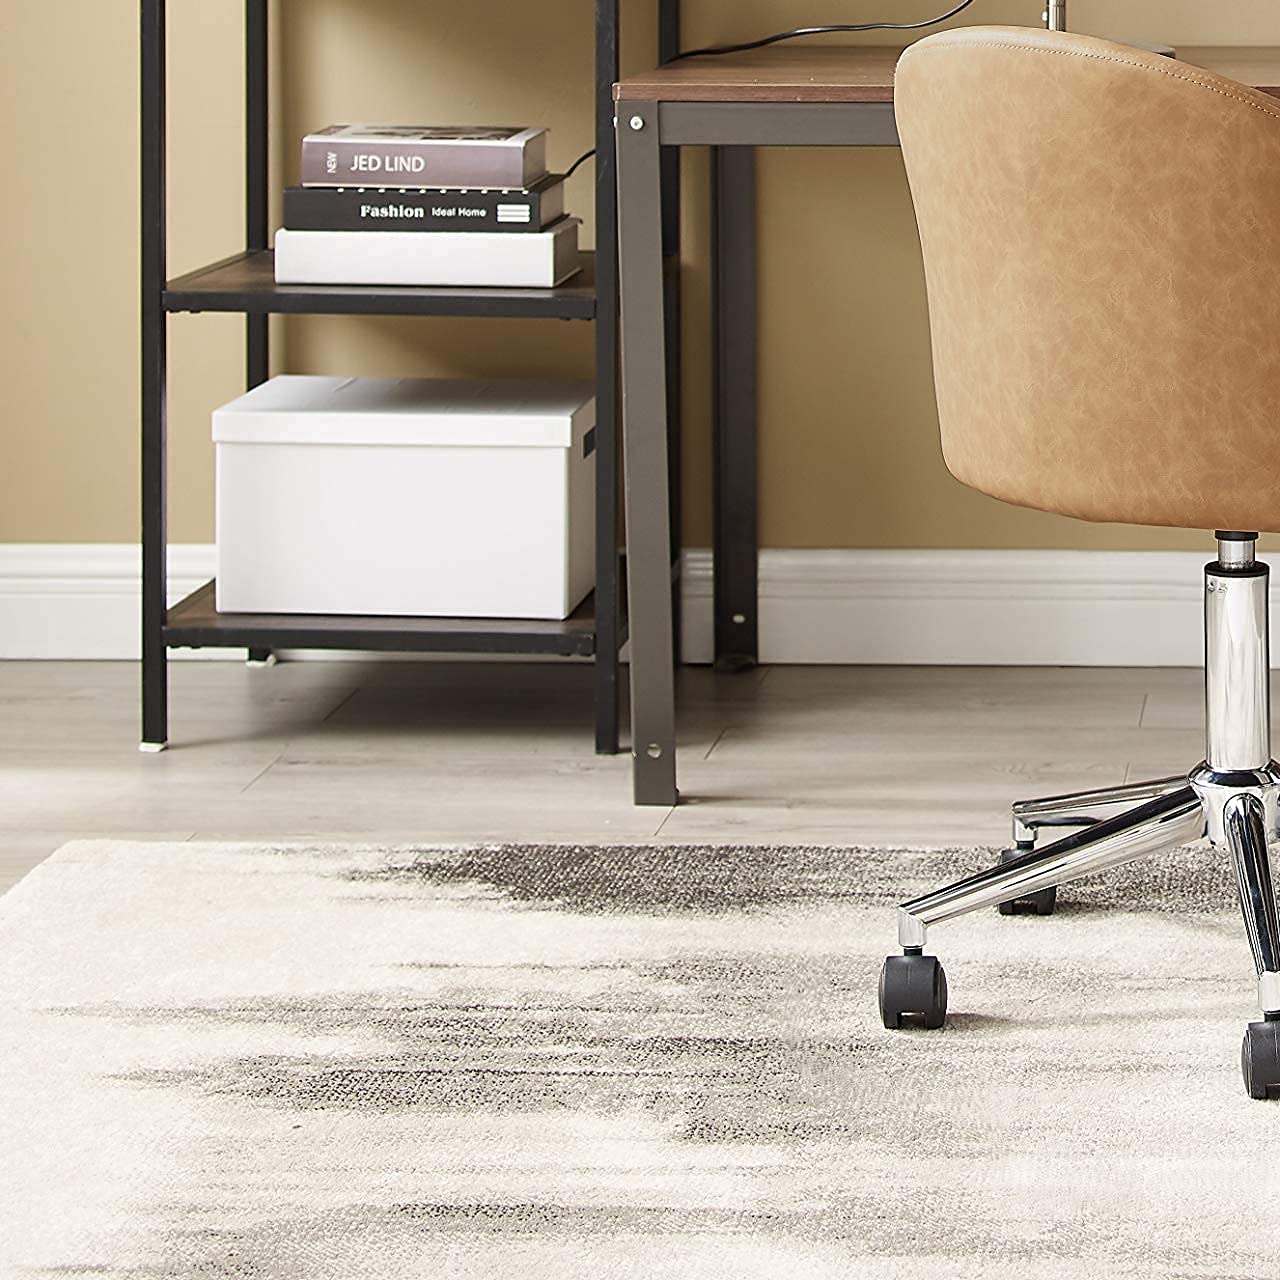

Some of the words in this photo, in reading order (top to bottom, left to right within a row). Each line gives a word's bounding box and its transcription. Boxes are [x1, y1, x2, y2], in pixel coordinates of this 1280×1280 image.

[350, 154, 382, 172] JED
[384, 155, 426, 173] LIND
[360, 204, 425, 218] Fashion
[431, 207, 456, 217] Ideal
[458, 207, 487, 217] Home
